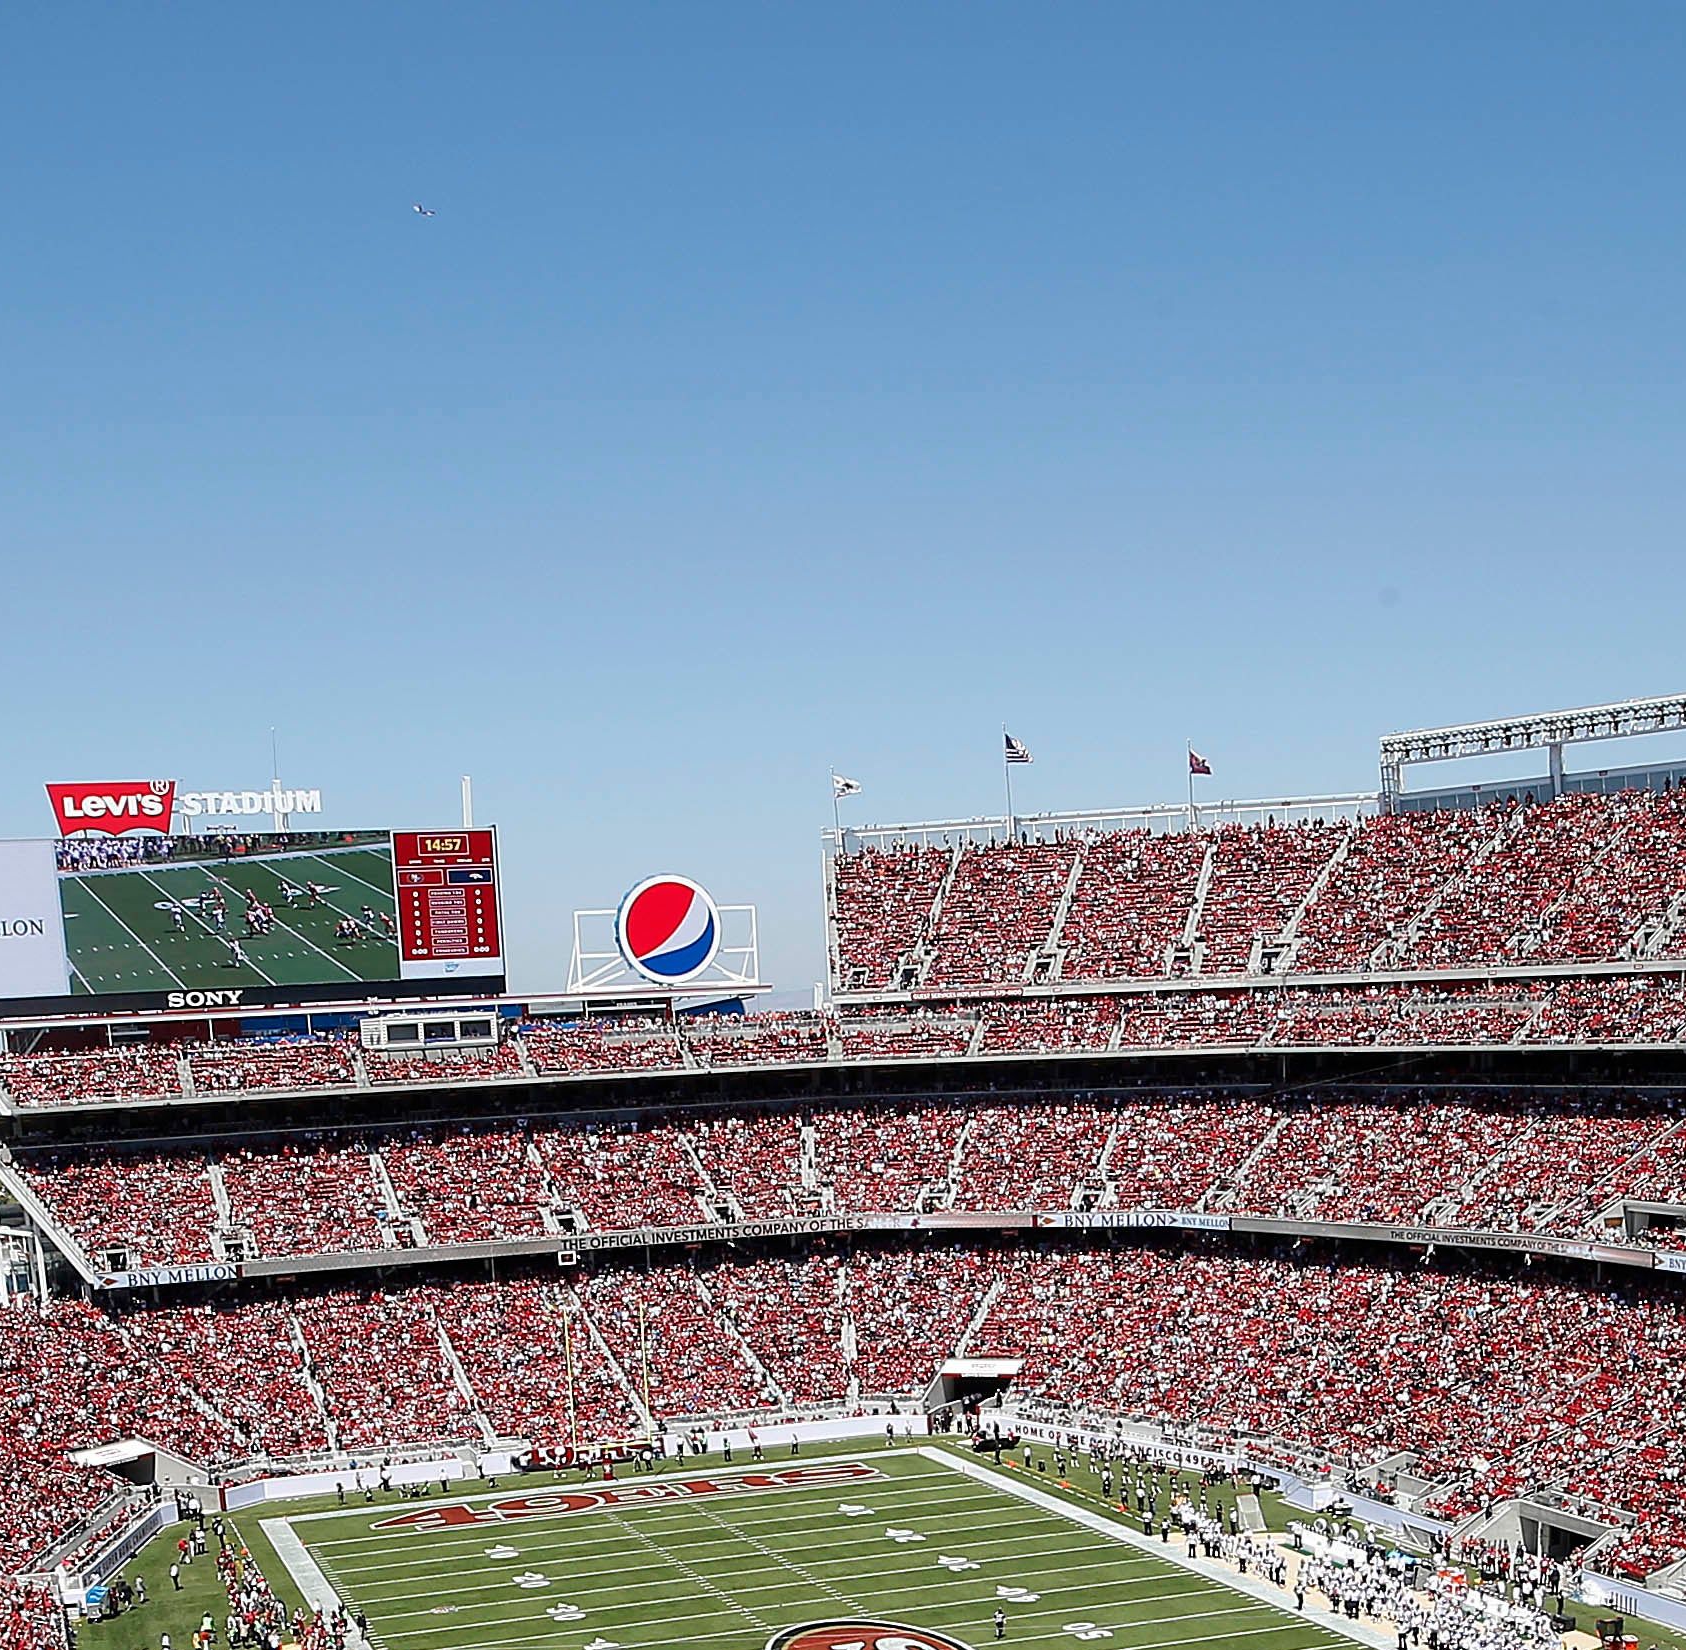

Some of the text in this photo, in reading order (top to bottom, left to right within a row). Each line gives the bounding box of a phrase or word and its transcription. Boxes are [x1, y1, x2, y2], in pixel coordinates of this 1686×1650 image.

[182, 790, 322, 816] STADIUM
[425, 838, 461, 851] 14:57
[168, 990, 243, 1008] SONY
[1064, 1212, 1167, 1227] BNY MELLON
[1181, 1216, 1229, 1228] BNY MELLON
[562, 1217, 852, 1250] THE OFFICIAL INVESTMENTS COMPANY OF THE
[1390, 1231, 1405, 1241] THE
[1406, 1232, 1440, 1243] OFFICIAL
[1442, 1233, 1496, 1247] INVESTMENTS
[1497, 1238, 1536, 1250] COMPANY
[1537, 1241, 1547, 1250] OF
[128, 1265, 238, 1287] BNY MELLON
[1015, 1423, 1046, 1440] HOME
[369, 1462, 892, 1531] 49ERS
[512, 1571, 551, 1588] 20
[545, 1602, 587, 1621] 30
[1062, 1621, 1114, 1640] 50
